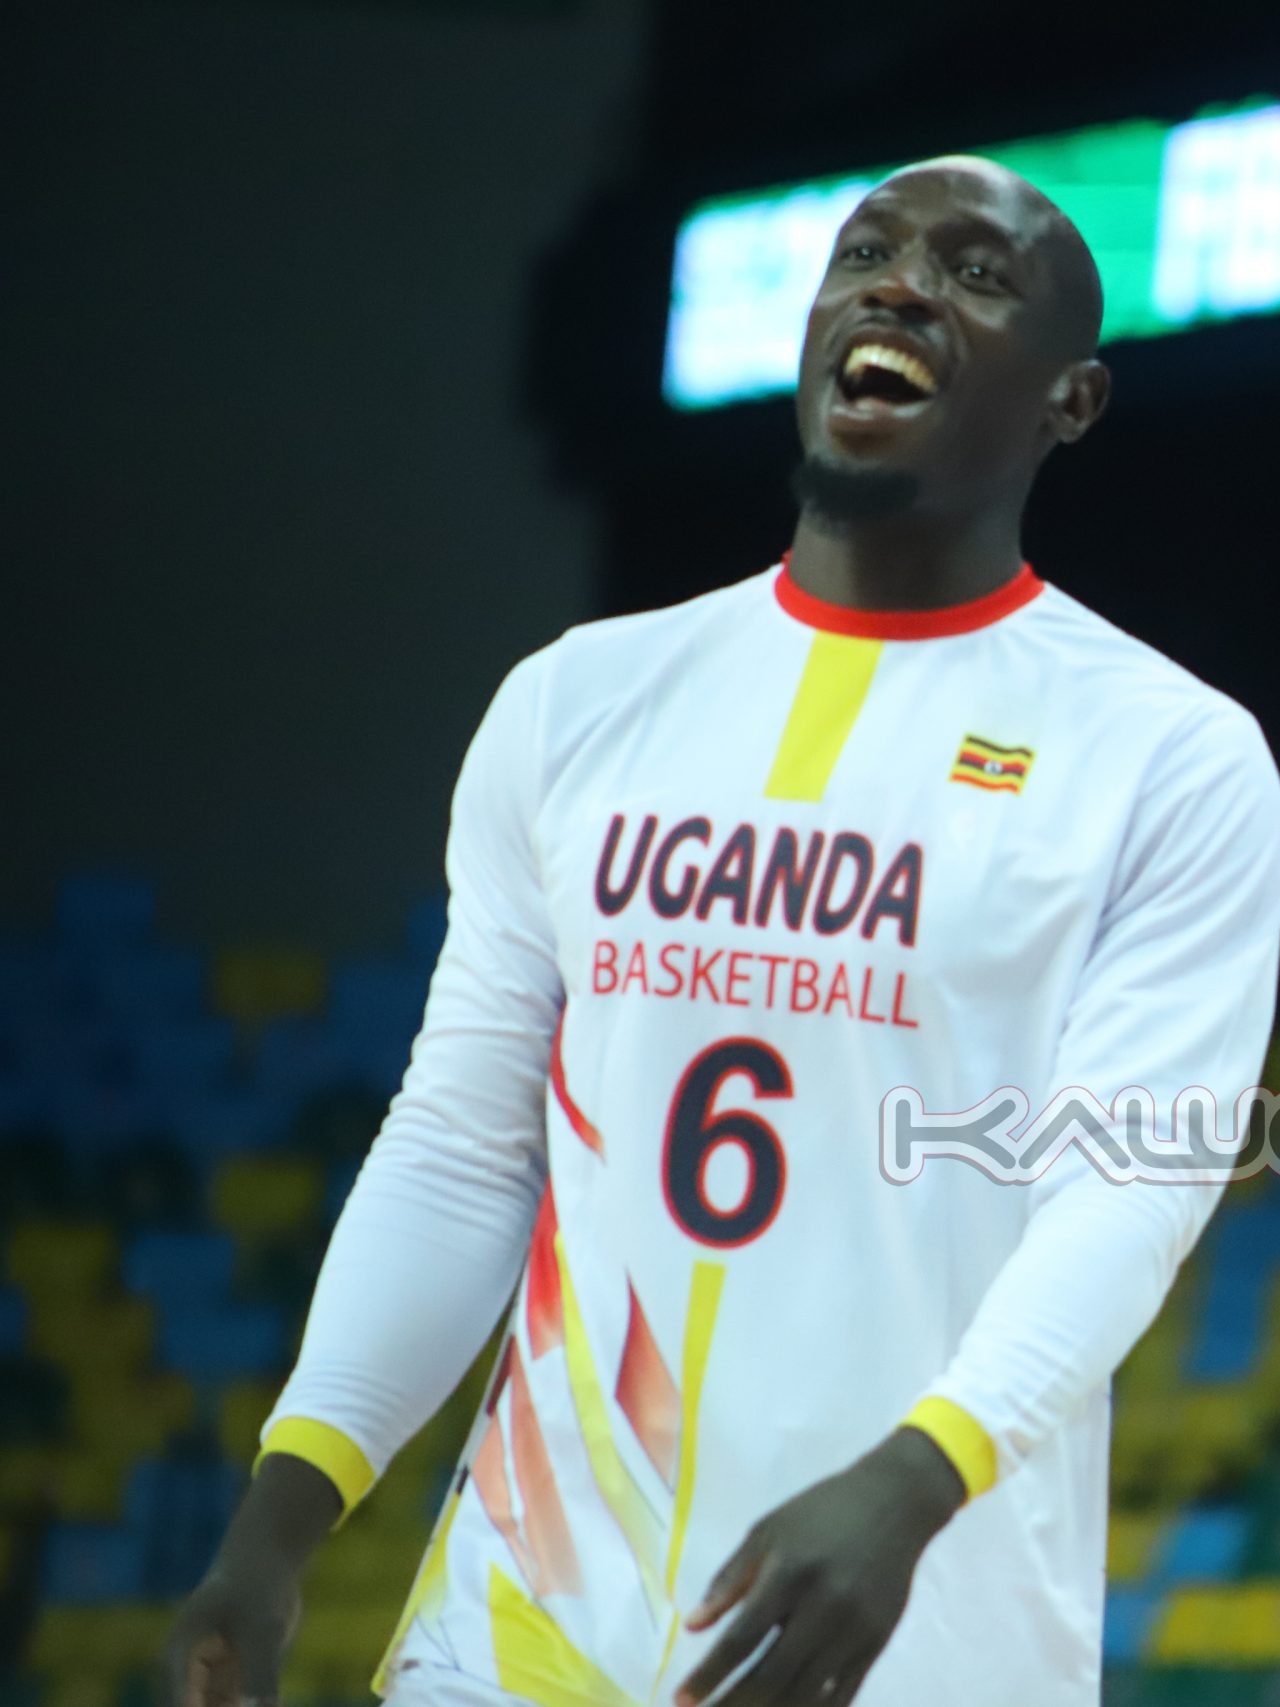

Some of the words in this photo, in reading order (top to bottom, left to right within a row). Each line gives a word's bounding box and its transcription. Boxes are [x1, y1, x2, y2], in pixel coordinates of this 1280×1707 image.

[594, 814, 923, 948] UGANDA
[592, 940, 920, 1028] BASKETBALL
[660, 1035, 795, 1250] 6
